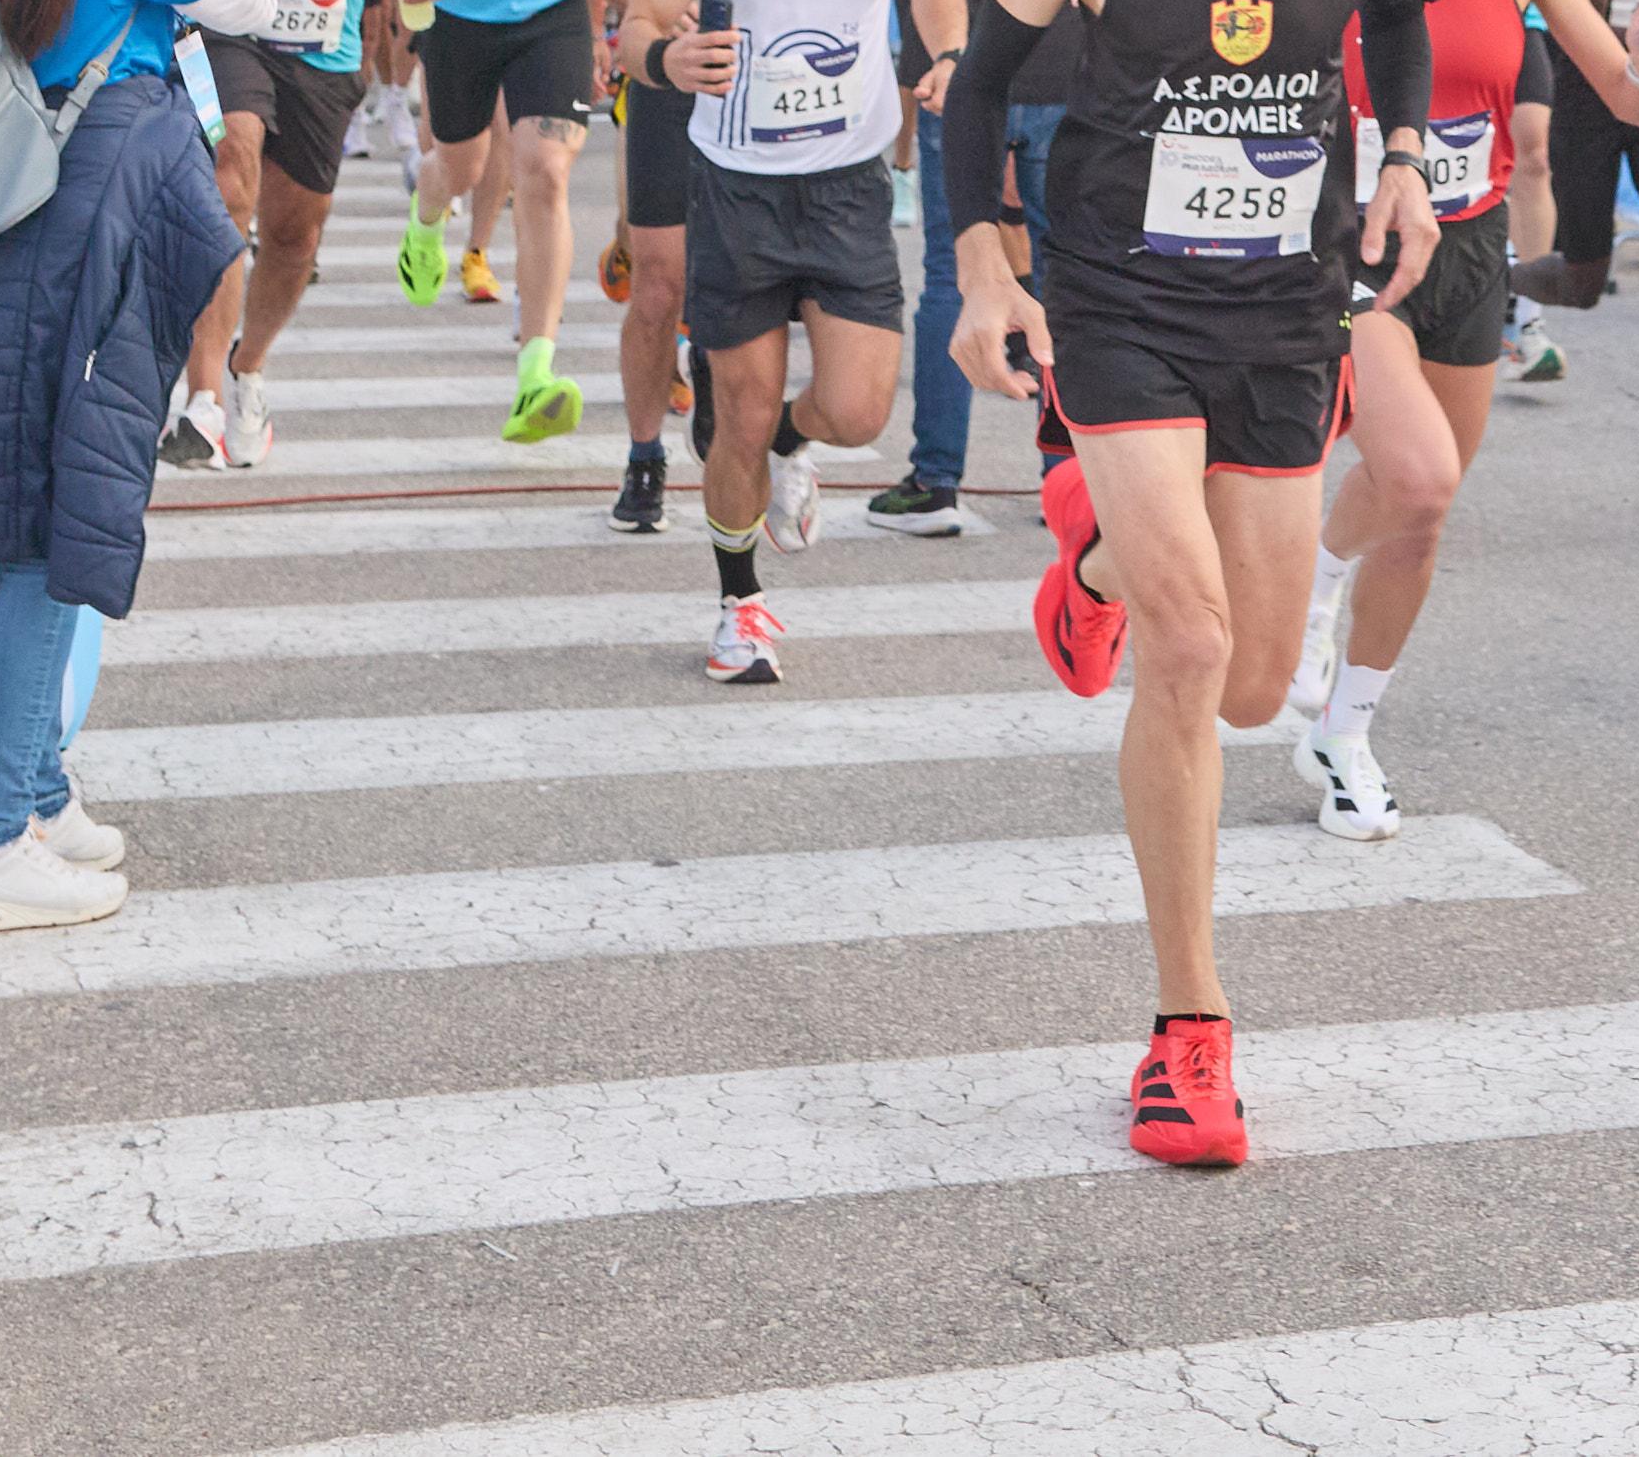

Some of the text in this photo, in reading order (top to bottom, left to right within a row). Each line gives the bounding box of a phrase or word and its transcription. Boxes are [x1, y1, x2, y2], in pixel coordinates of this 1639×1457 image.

[273, 11, 329, 31] 2678
[774, 82, 844, 115] 4211
[1162, 102, 1304, 134] ΔΡΟΜΕΙΣ
[1424, 155, 1469, 185] 03
[1184, 186, 1286, 219] 4258
